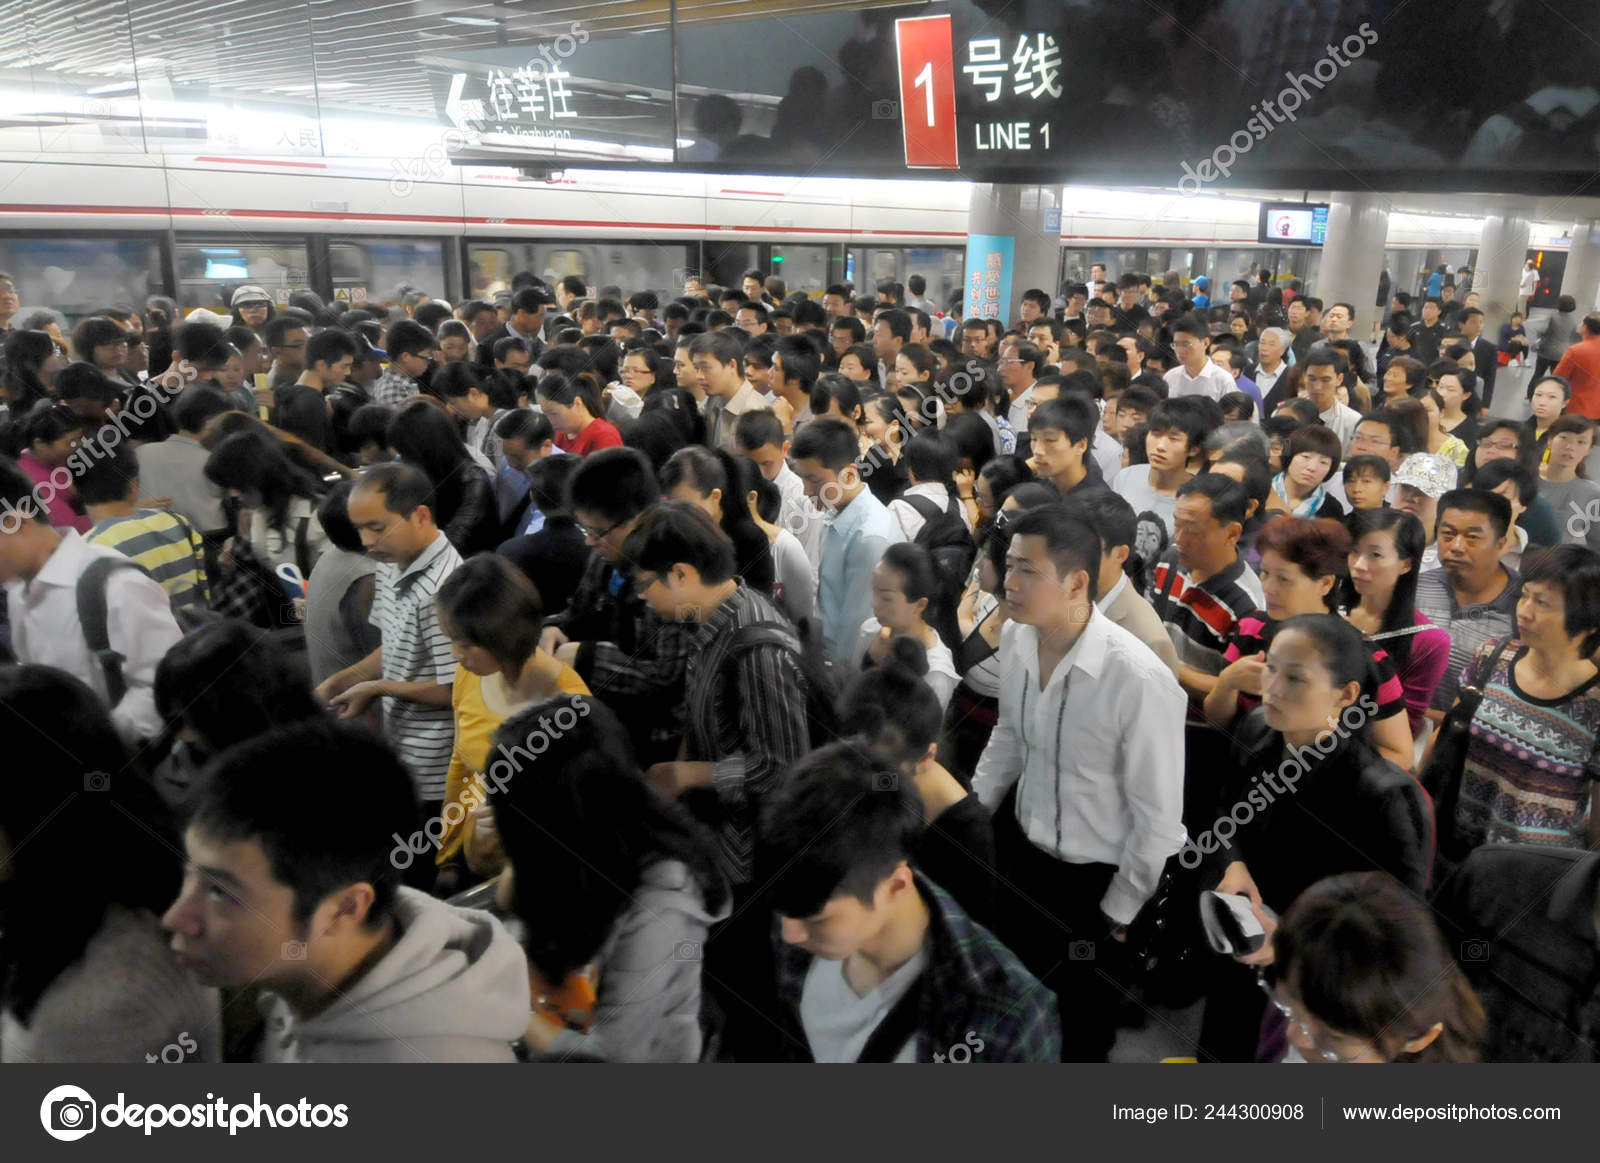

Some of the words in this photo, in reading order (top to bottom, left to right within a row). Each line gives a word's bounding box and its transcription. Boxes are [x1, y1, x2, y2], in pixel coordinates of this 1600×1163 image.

[914, 62, 935, 127] 1
[962, 32, 1063, 102] 号线
[975, 122, 1032, 150] LINE
[1039, 122, 1050, 150] 1
